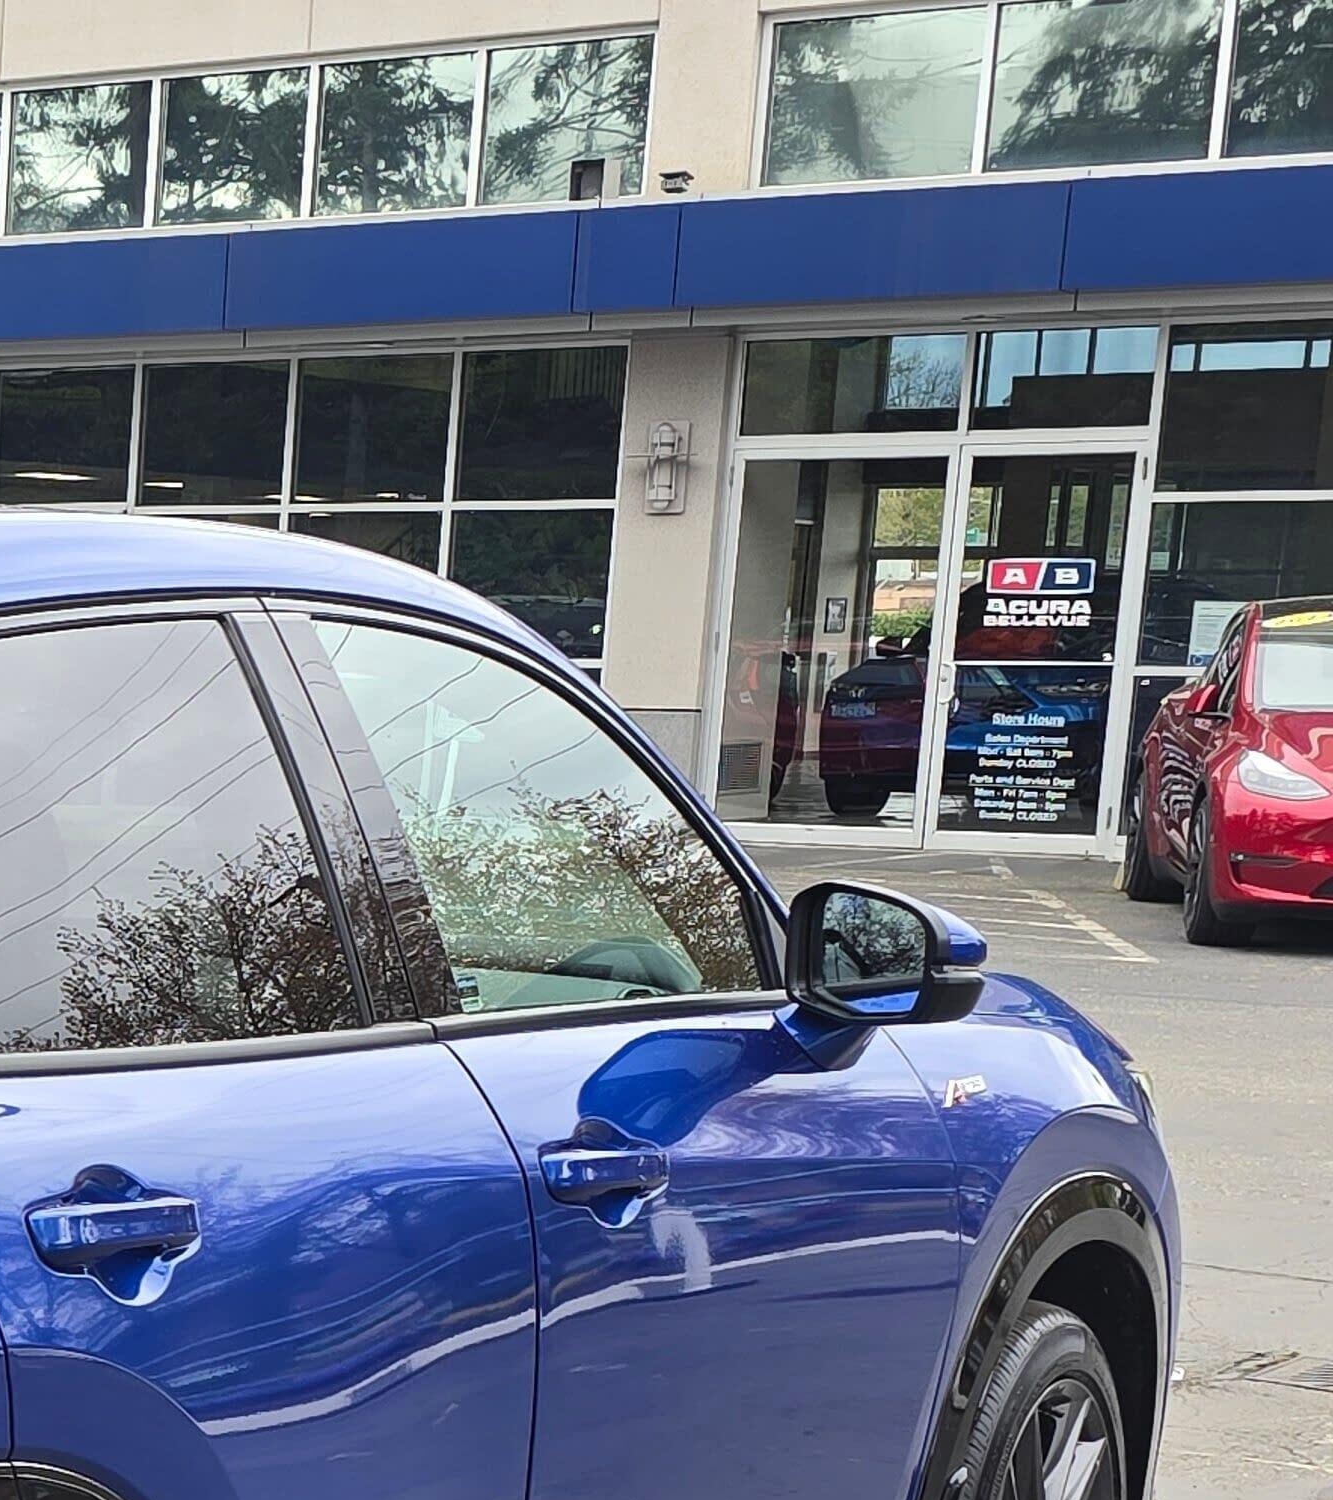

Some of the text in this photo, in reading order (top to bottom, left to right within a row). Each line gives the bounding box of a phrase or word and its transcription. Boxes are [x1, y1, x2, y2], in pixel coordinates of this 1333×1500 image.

[1001, 568, 1080, 585] A B
[985, 598, 1092, 615] ACURA
[983, 615, 1091, 627] BELLEVUE
[992, 713, 1066, 727] Store Hours
[978, 757, 1057, 769] Sunday CLOSED
[969, 774, 994, 784] Parts
[995, 775, 1014, 784] and
[1015, 775, 1051, 785] Service
[978, 810, 1058, 821] Sunday CLOSED
